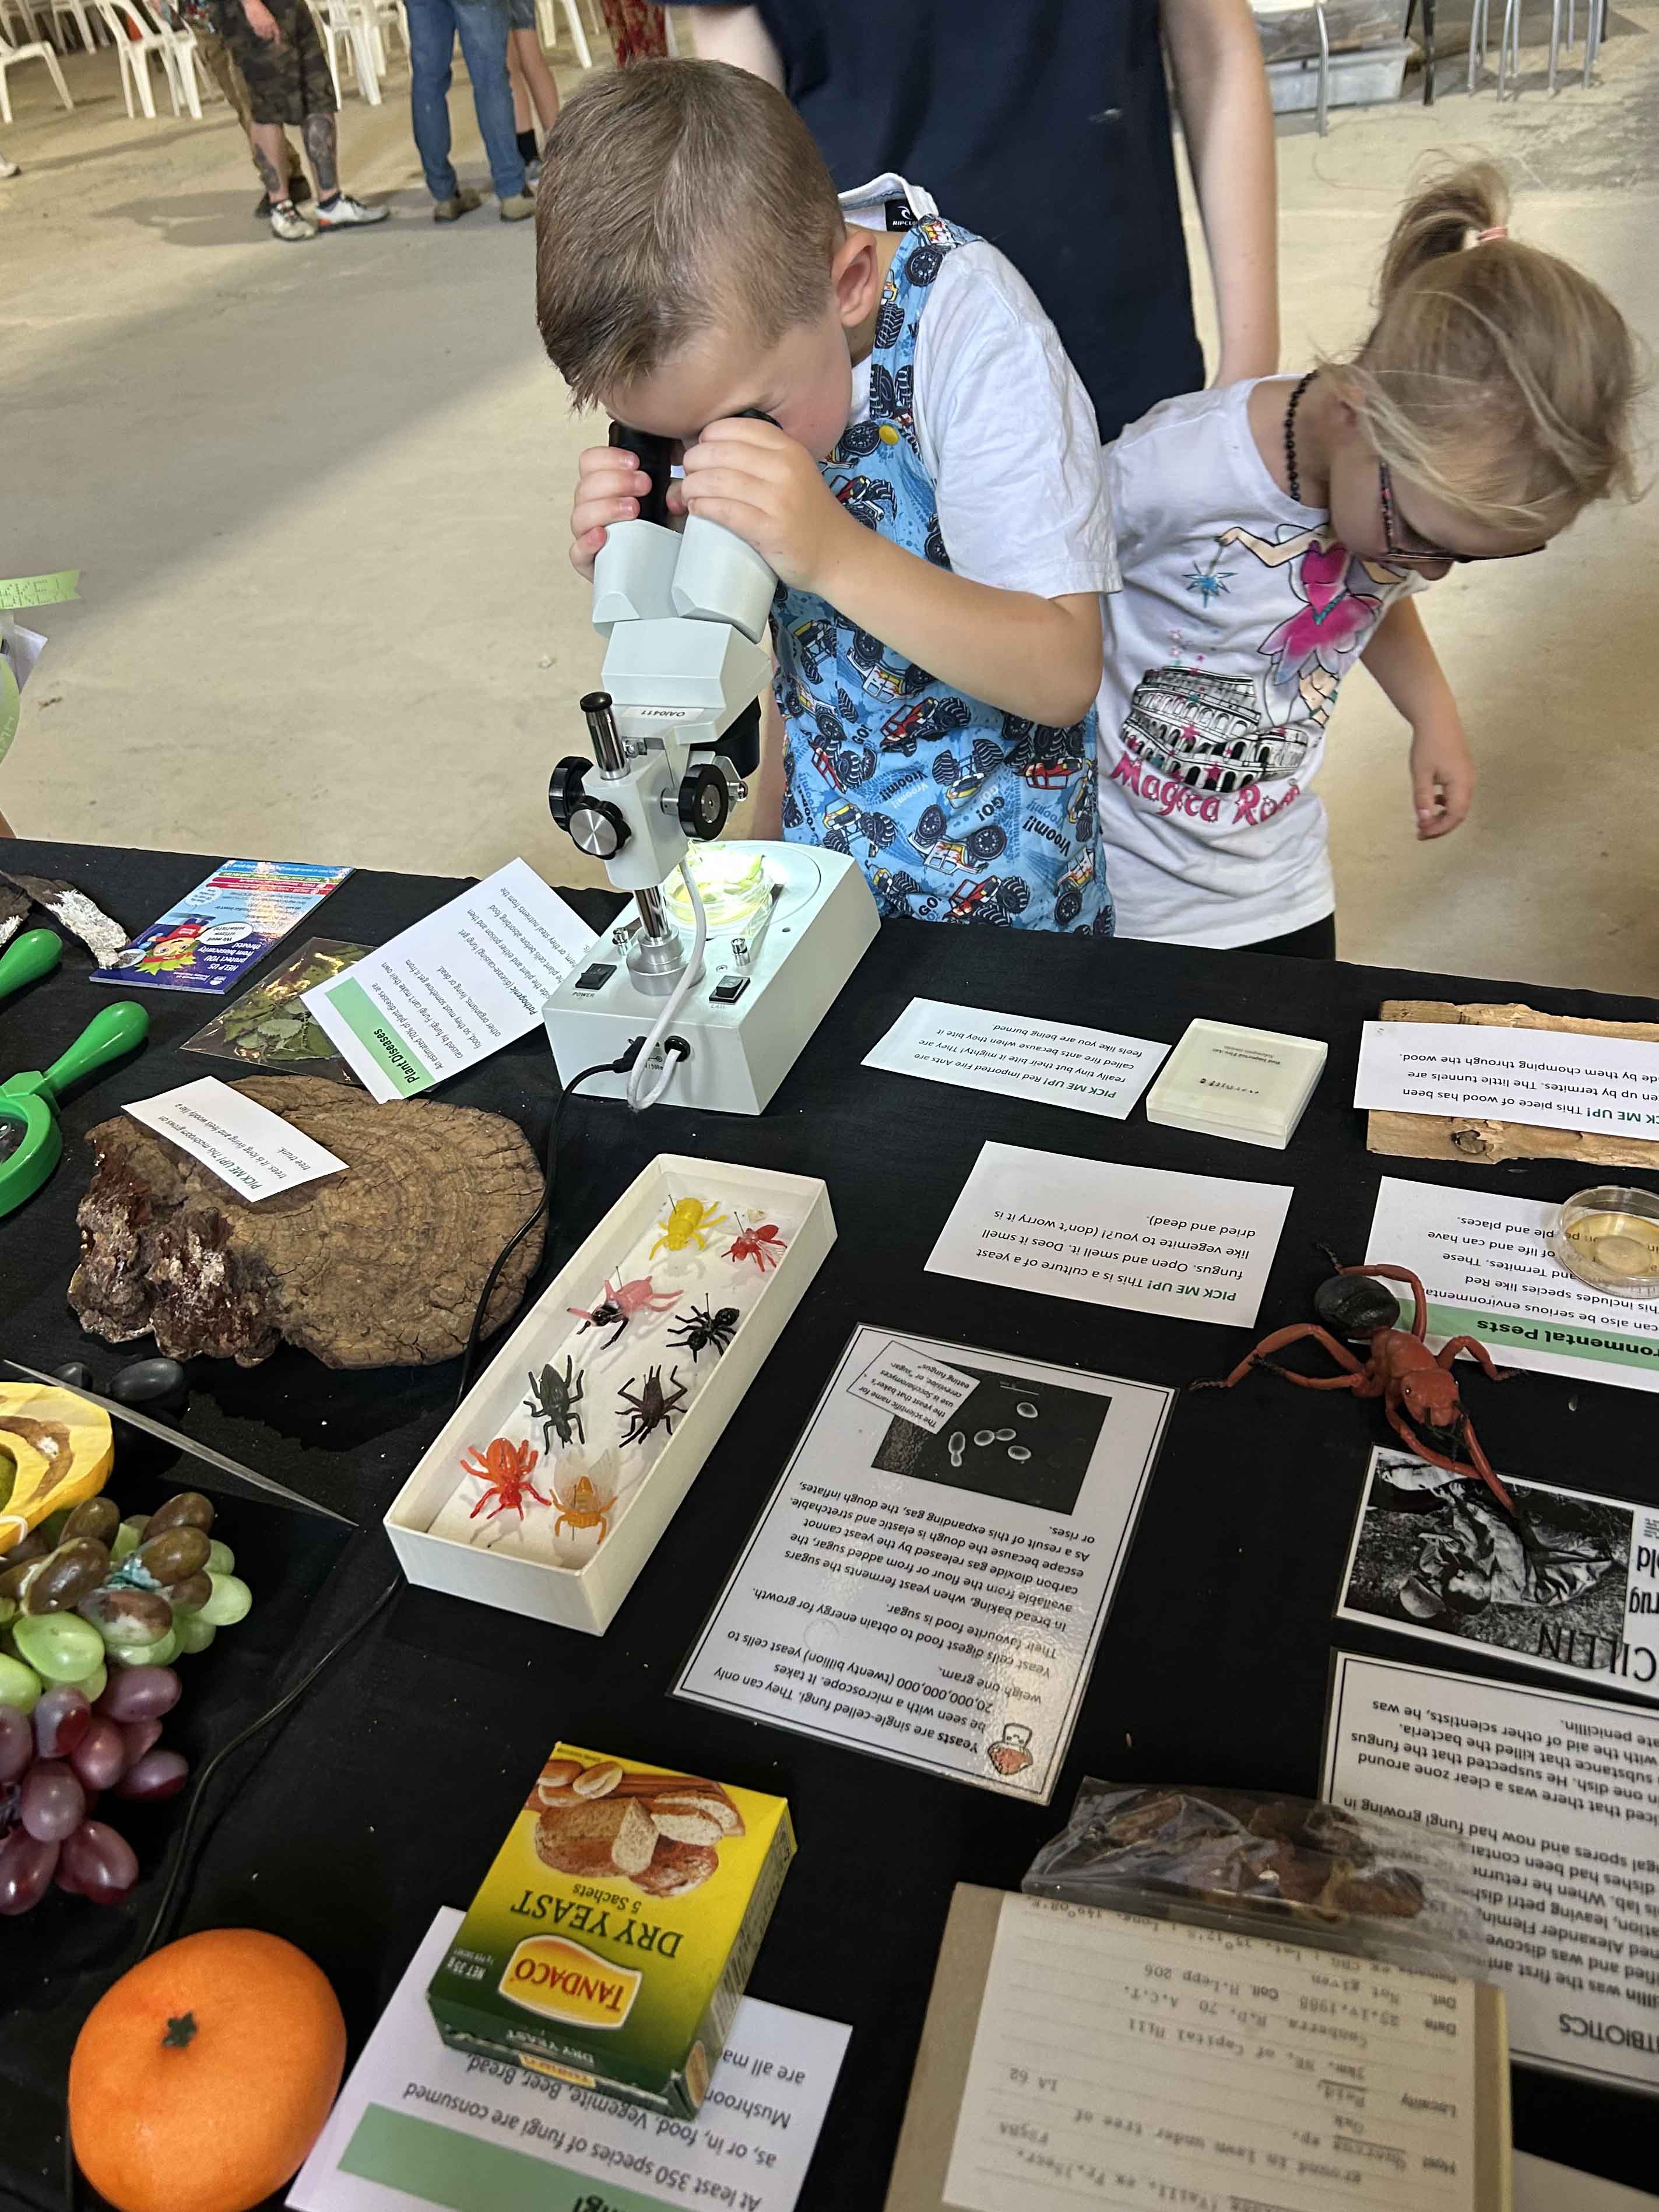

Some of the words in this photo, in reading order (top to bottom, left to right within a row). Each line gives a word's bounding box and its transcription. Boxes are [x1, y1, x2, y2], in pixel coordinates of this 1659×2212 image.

[197, 945, 237, 956] biosecurity
[381, 962, 392, 973] own
[389, 972, 402, 985] their
[371, 982, 381, 992] are
[399, 983, 412, 997] make
[378, 991, 396, 1010] diseases
[392, 1009, 407, 1023] plant
[418, 1007, 433, 1023] Fungi
[405, 1027, 419, 1040] 70%
[440, 1034, 449, 1043] by
[374, 1028, 403, 1063] Diseases
[413, 1038, 437, 1062] estimated
[444, 1041, 463, 1058] caused
[936, 1042, 957, 1052] They
[959, 1047, 997, 1057] mighty!
[434, 1061, 443, 1069] An
[932, 1057, 953, 1065] Ants
[955, 1061, 972, 1069] Fire
[1008, 1056, 1028, 1064] bite
[1029, 1060, 1053, 1068] their
[396, 1060, 420, 1083] Plant
[973, 1065, 1020, 1078] Imported
[1055, 1064, 1073, 1073] but
[1074, 1068, 1094, 1077] tiny
[1021, 1074, 1042, 1082] Red
[1043, 1077, 1064, 1087] UP!
[1096, 1072, 1126, 1082] really
[1431, 1073, 1477, 1083] tunnels
[1481, 1077, 1509, 1087] little
[1066, 1083, 1087, 1091] ME
[1513, 1080, 1536, 1089] The
[1541, 1083, 1598, 1096] termites.
[1088, 1087, 1116, 1098] PICK
[1403, 1089, 1433, 1099] been
[1437, 1092, 1458, 1101] has
[1463, 1094, 1498, 1103] wood
[1602, 1087, 1616, 1098] by
[1621, 1090, 1637, 1098] up
[1519, 1100, 1552, 1109] piece
[1556, 1104, 1581, 1114] This
[1587, 1107, 1612, 1119] UP!
[1618, 1111, 1640, 1122] ME
[216, 1157, 234, 1168] UP!
[228, 1166, 247, 1177] ME
[240, 1175, 262, 1189] PICK
[1147, 1215, 1187, 1229] dead).
[1190, 1223, 1216, 1231] and
[1457, 1217, 1501, 1230] places.
[982, 1229, 1016, 1241] smell
[1219, 1227, 1255, 1238] dried
[1506, 1224, 1530, 1234] and
[1018, 1236, 1028, 1245] it
[1428, 1231, 1457, 1244] have
[1463, 1237, 1485, 1245] can
[1031, 1238, 1063, 1251] Does
[1068, 1245, 1080, 1255] it.
[1489, 1241, 1513, 1250] and
[976, 1249, 1010, 1261] yeast
[1083, 1248, 1119, 1259] smell
[1517, 1246, 1537, 1256] life
[1541, 1249, 1555, 1260] of
[1122, 1254, 1148, 1264] and
[1442, 1253, 1480, 1266] These
[1041, 1262, 1088, 1275] culture
[1152, 1259, 1187, 1272] Open
[1486, 1260, 1546, 1277] Termites.
[1102, 1273, 1113, 1282] is
[1193, 1265, 1242, 1280] fungus.
[1117, 1275, 1143, 1287] This
[1147, 1280, 1172, 1291] UP!
[1465, 1276, 1489, 1287] Red
[1495, 1280, 1517, 1291] like
[1176, 1284, 1200, 1295] ME
[1203, 1288, 1236, 1301] PICK
[1521, 1285, 1571, 1298] species
[1576, 1294, 1632, 1309] includes
[1524, 1305, 1574, 1318] serious
[1579, 1313, 1595, 1323] be
[1601, 1317, 1628, 1327] also
[1477, 1320, 1538, 1340] Pests
[790, 1498, 853, 1518] stretchable.
[854, 1514, 877, 1525] and
[878, 1519, 915, 1535] elastic
[918, 1529, 926, 1539] is
[929, 1532, 965, 1549] dough
[968, 1542, 987, 1554] the
[991, 1548, 1039, 1568] because
[1042, 1561, 1083, 1577] escape
[727, 1631, 740, 1641] to
[742, 1634, 768, 1647] cells
[769, 1642, 802, 1657] yeast
[803, 1649, 845, 1672] billion)
[713, 1667, 740, 1681] only
[846, 1662, 894, 1686] (twenty
[742, 1676, 763, 1688] can
[764, 1681, 792, 1700] They
[896, 1677, 993, 1714] 20,000,000,000
[1372, 1701, 1399, 1713] was
[832, 1702, 911, 1732] single-celled
[1404, 1707, 1421, 1720] he
[1426, 1709, 1496, 1733] scientists,
[913, 1725, 934, 1737] are
[1502, 1727, 1542, 1742] other
[937, 1732, 977, 1753] Yeasts
[1546, 1736, 1562, 1747] of
[1566, 1739, 1588, 1752] aid
[1593, 1745, 1619, 1760] the
[1623, 1751, 1657, 1765] with
[572, 1884, 629, 1910] Sachets
[630, 1901, 642, 1914] 5
[509, 1890, 610, 1938] YEAST
[613, 1919, 683, 1958] DRY
[509, 1958, 623, 2012] TANDACO
[402, 2083, 488, 2119] consumed
[491, 2109, 519, 2129] are
[520, 2118, 565, 2150] fungi
[564, 2136, 587, 2153] of
[590, 2143, 653, 2175] species
[655, 2166, 691, 2190] 350
[693, 2178, 736, 2204] least
[739, 2192, 762, 2210] At
